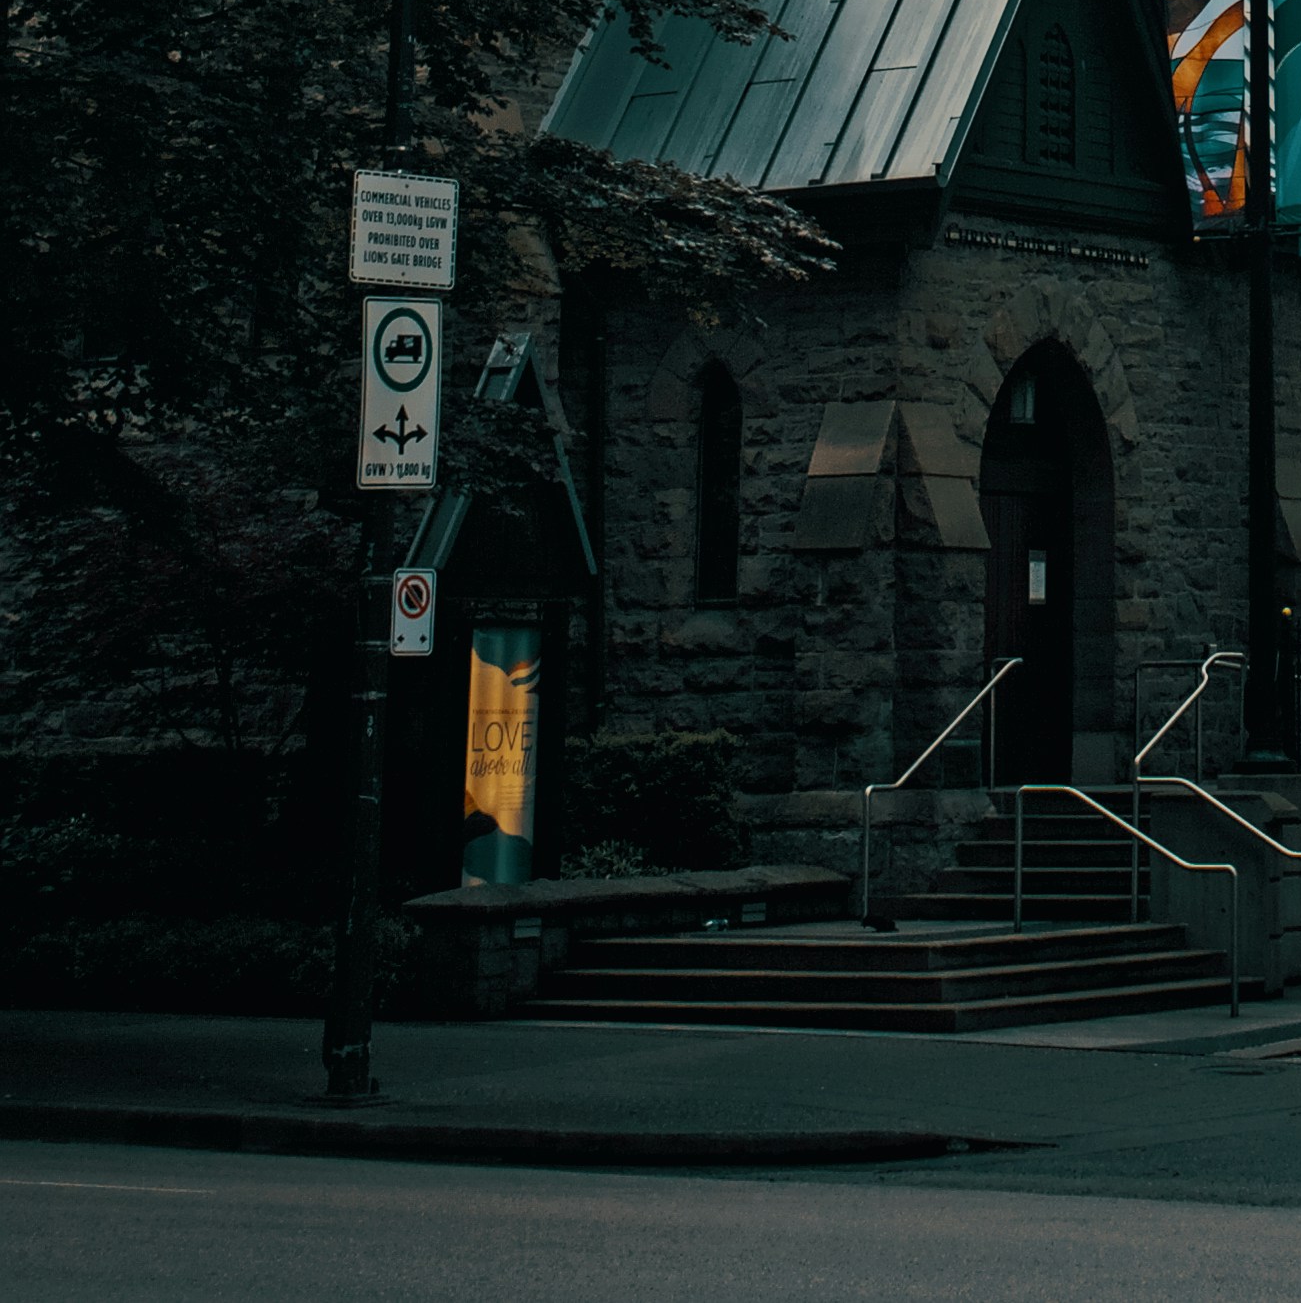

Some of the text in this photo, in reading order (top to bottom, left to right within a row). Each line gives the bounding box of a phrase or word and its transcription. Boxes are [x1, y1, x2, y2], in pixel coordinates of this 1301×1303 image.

[360, 190, 451, 211] COMMERCIAL VEHICLES
[362, 209, 383, 223] OVER
[426, 215, 448, 229] LGVW
[368, 231, 440, 250] PROHIBITED OVER
[363, 251, 443, 269] LIONS GATE BRIDGE
[365, 462, 387, 476] GVW
[421, 462, 431, 479] kg
[471, 721, 534, 752] LOVE
[470, 753, 530, 778] above all
